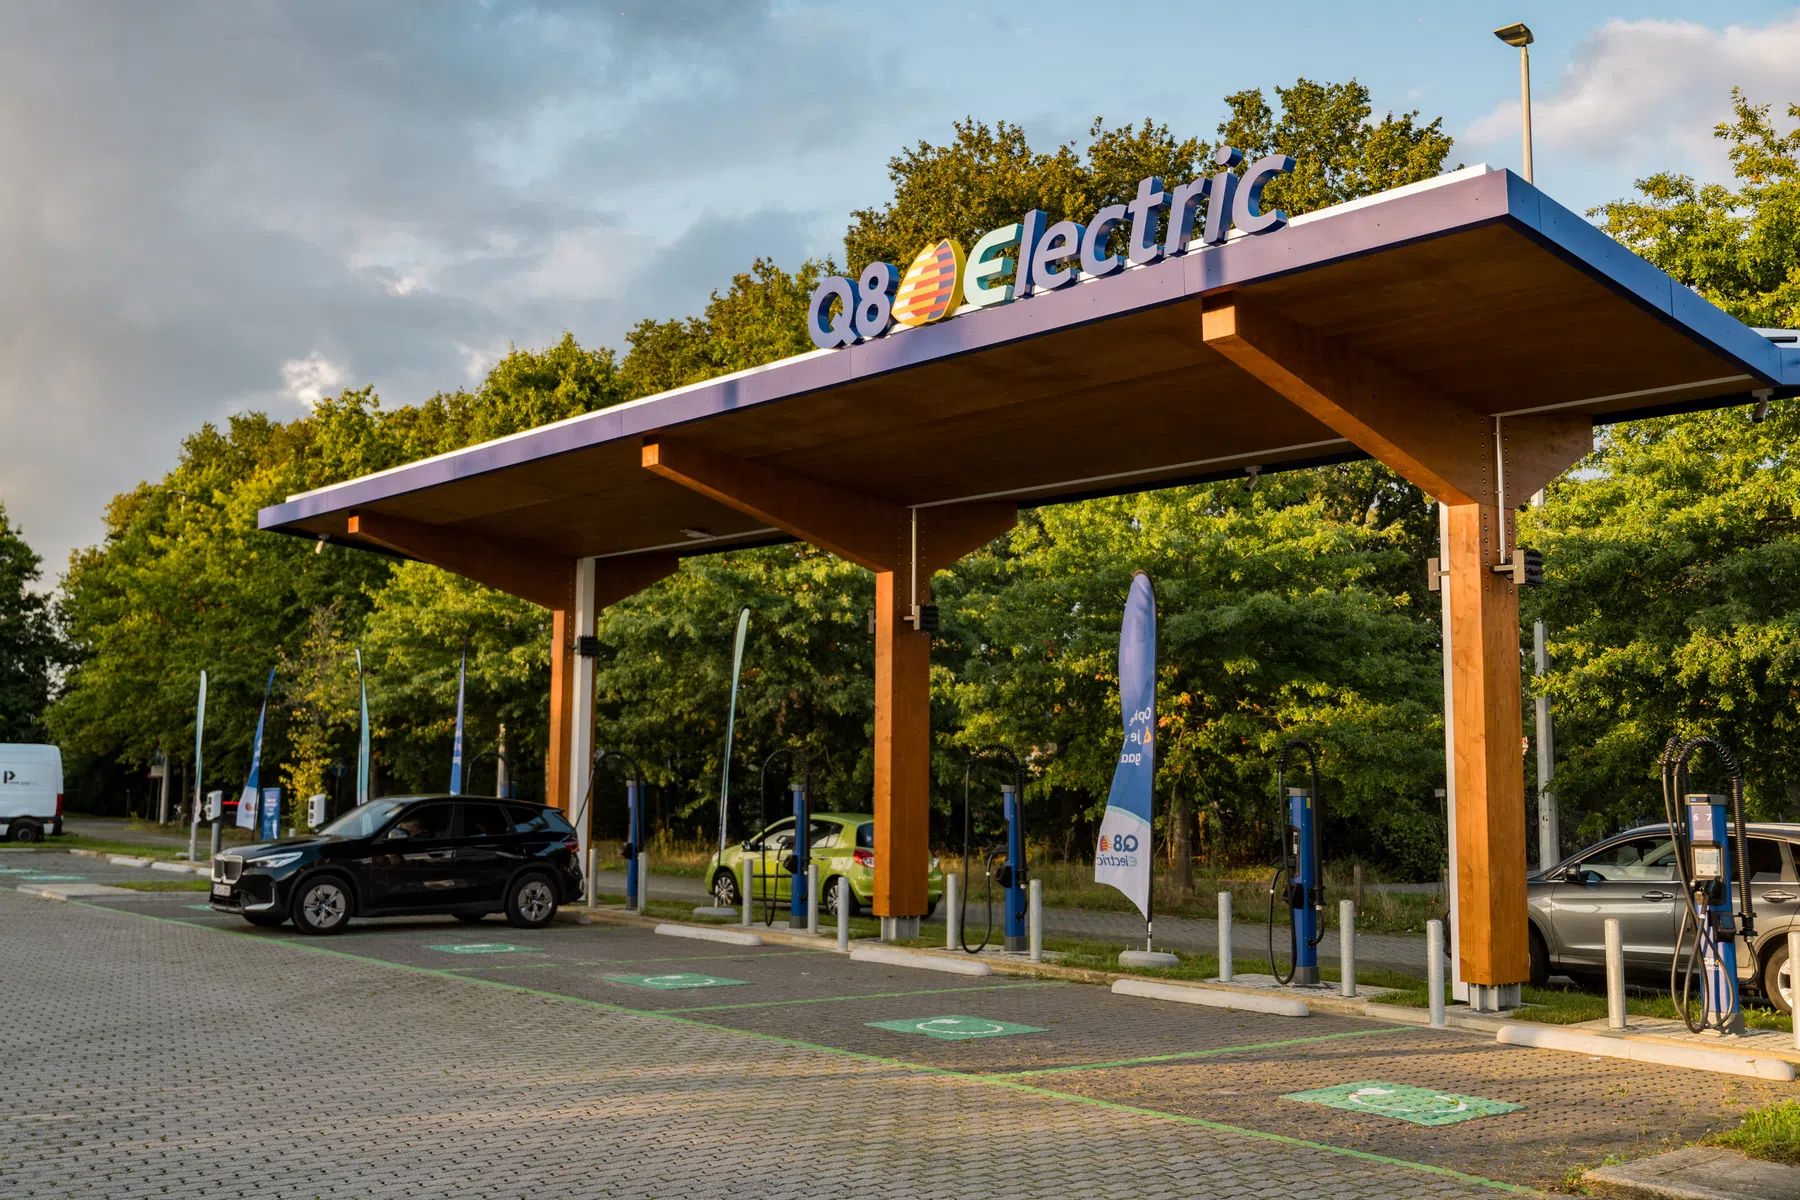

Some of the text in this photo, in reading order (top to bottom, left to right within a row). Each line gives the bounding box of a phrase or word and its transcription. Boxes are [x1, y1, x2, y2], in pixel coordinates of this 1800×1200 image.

[808, 145, 1297, 349] Q8 Electric
[1692, 813, 1712, 822] 6 7
